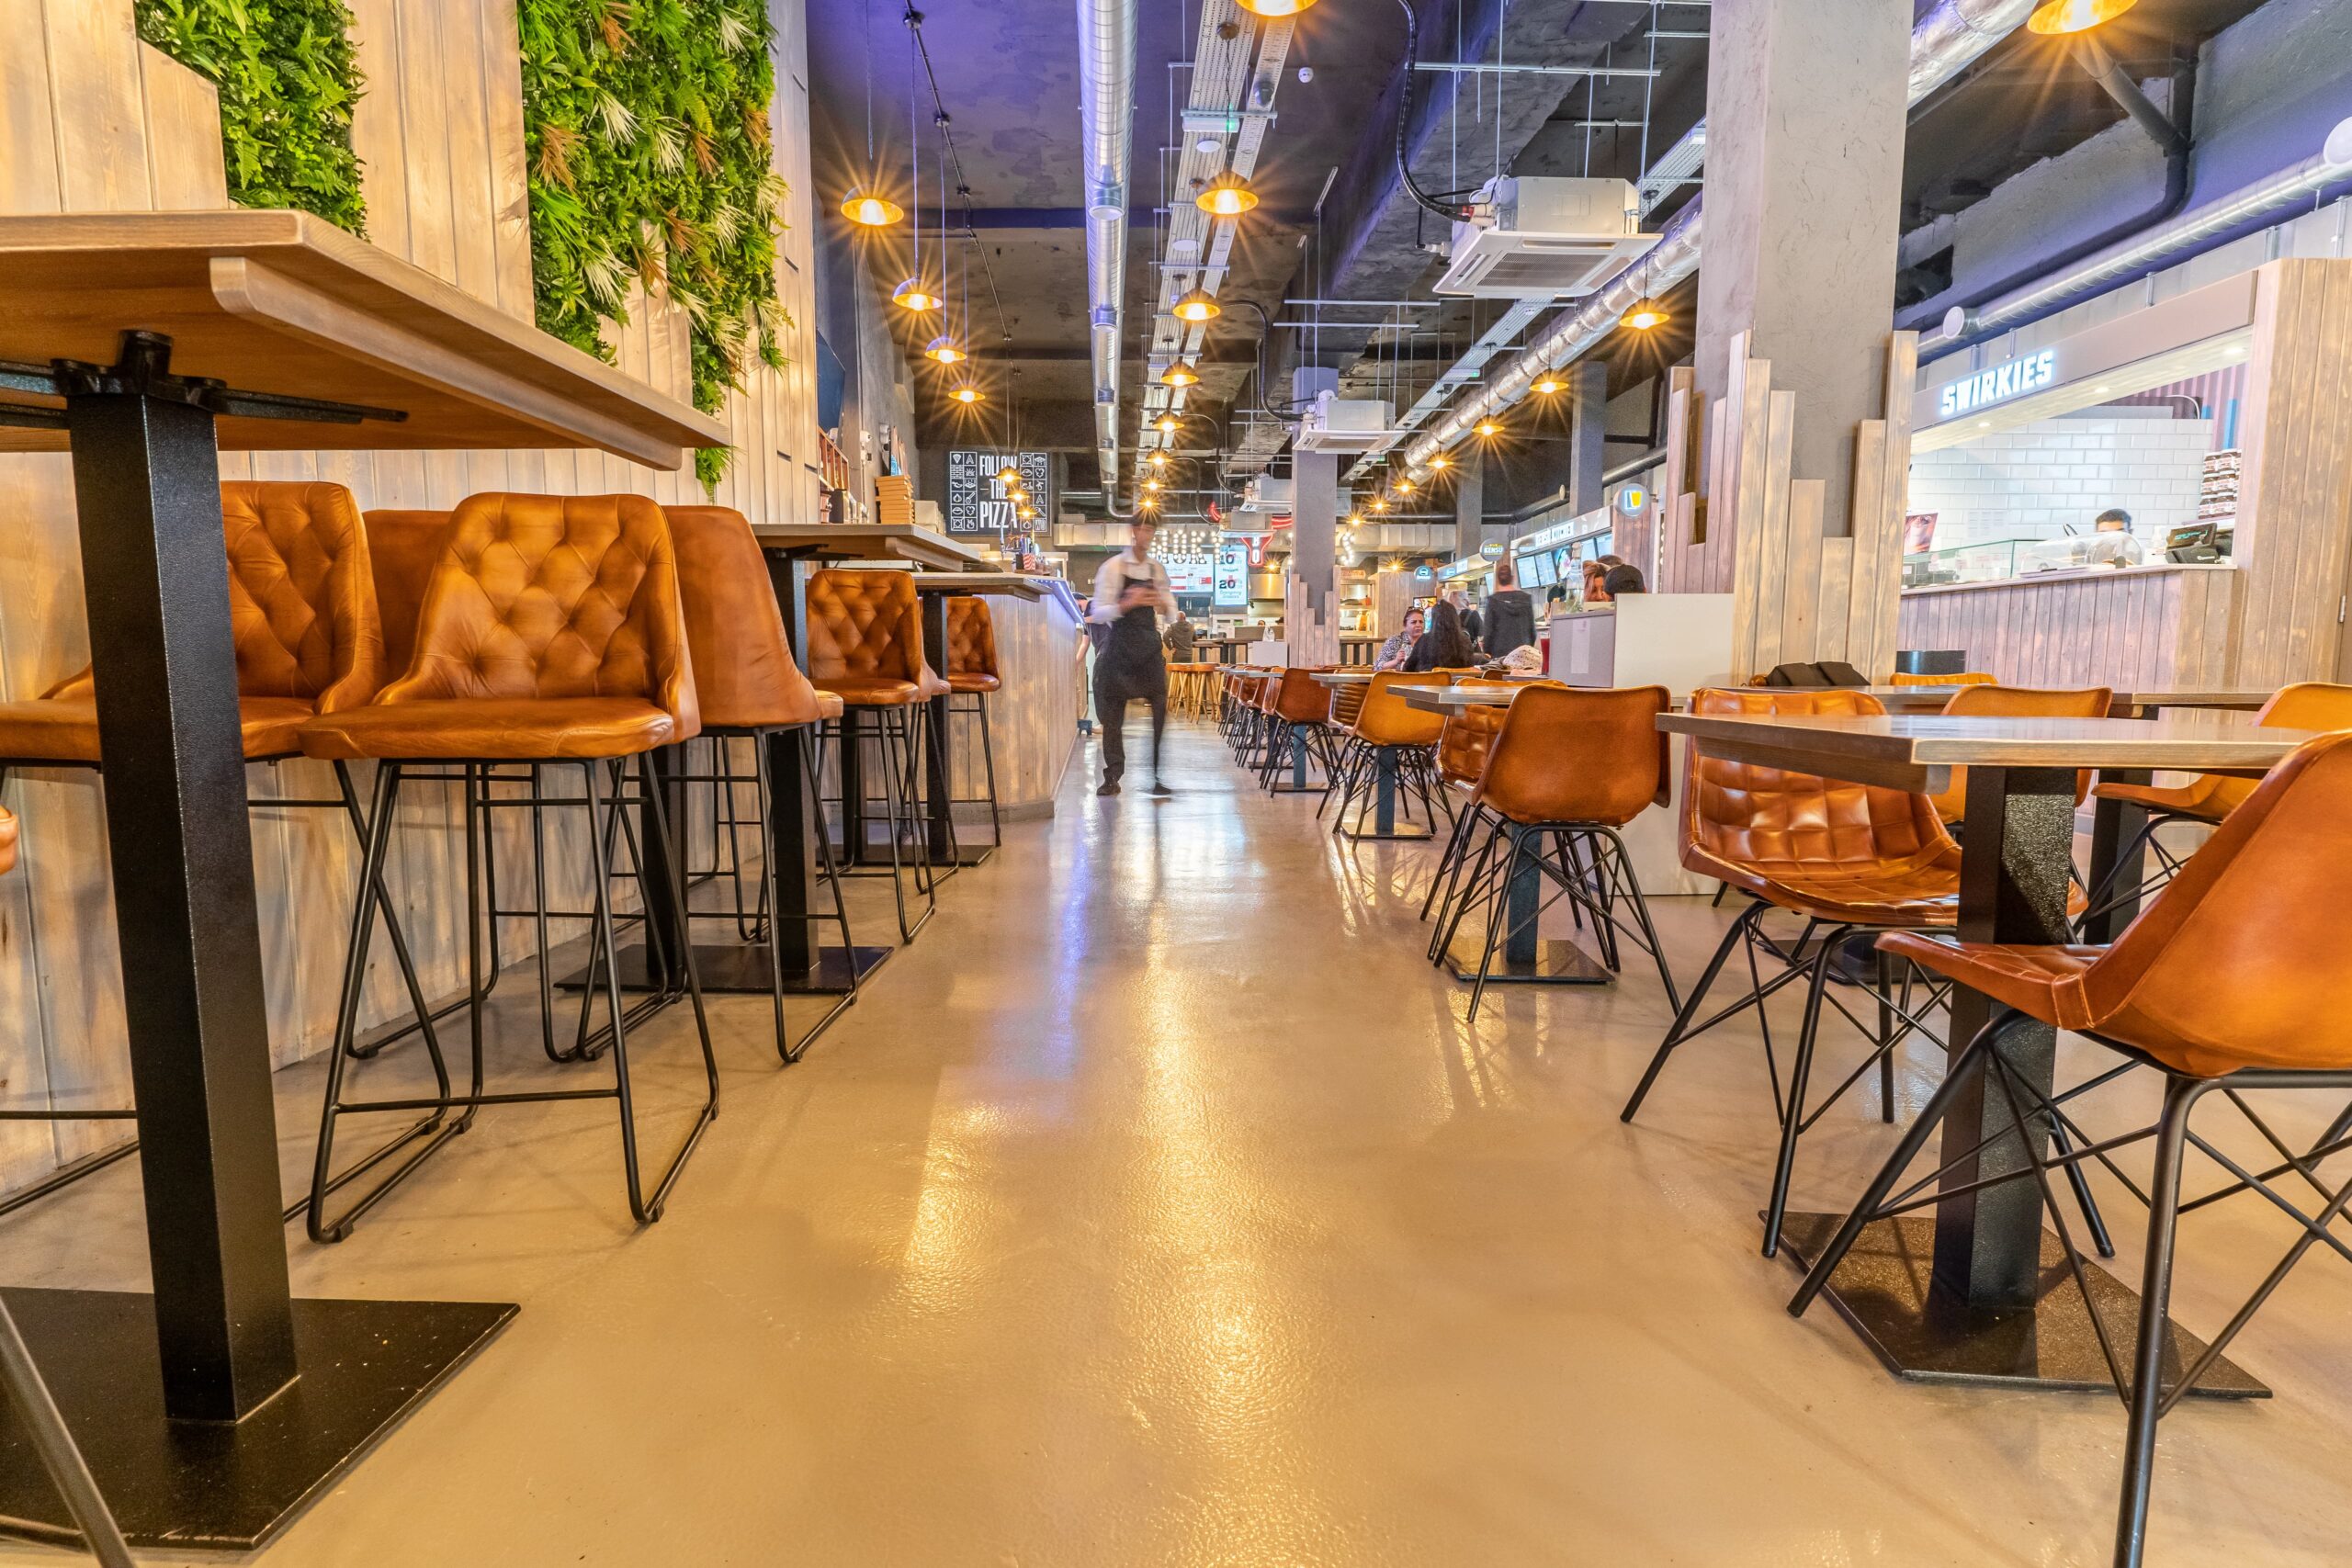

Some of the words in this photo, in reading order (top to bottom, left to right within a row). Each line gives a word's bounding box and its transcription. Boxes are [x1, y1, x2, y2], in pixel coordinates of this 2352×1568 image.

[1940, 350, 2054, 415] SWIRKIES
[979, 456, 1017, 476] FOLLOW
[989, 479, 1009, 499] THE
[979, 501, 1017, 528] PIZZA
